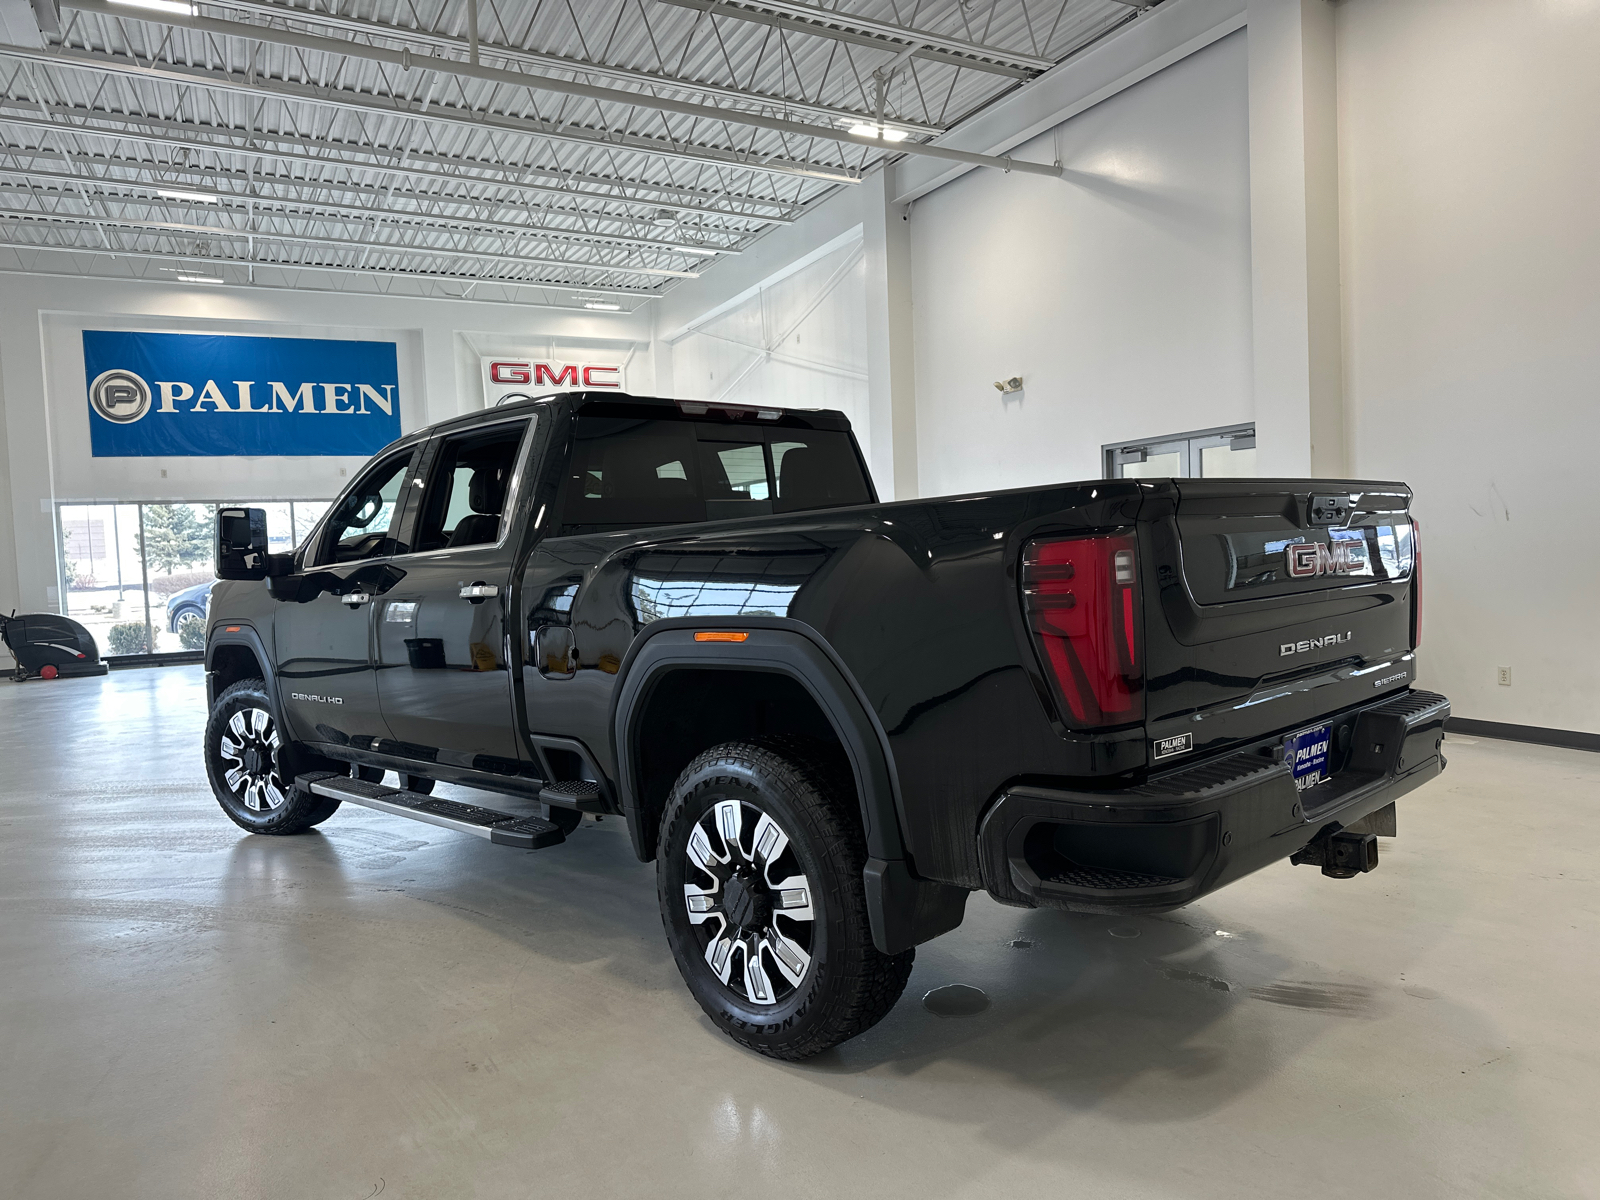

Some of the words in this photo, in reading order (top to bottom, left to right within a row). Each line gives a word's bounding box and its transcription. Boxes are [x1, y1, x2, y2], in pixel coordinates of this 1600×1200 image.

[490, 360, 621, 389] GMC
[154, 379, 396, 416] PALMEN
[1287, 539, 1365, 578] GMC
[1280, 630, 1352, 657] DENALI
[1373, 671, 1408, 688] SIERRA
[291, 692, 327, 703] DENALI
[327, 696, 344, 704] HD
[1161, 736, 1186, 750] PALMEN
[1296, 739, 1329, 763] PALMEN
[719, 961, 824, 1035] WRANGLER
